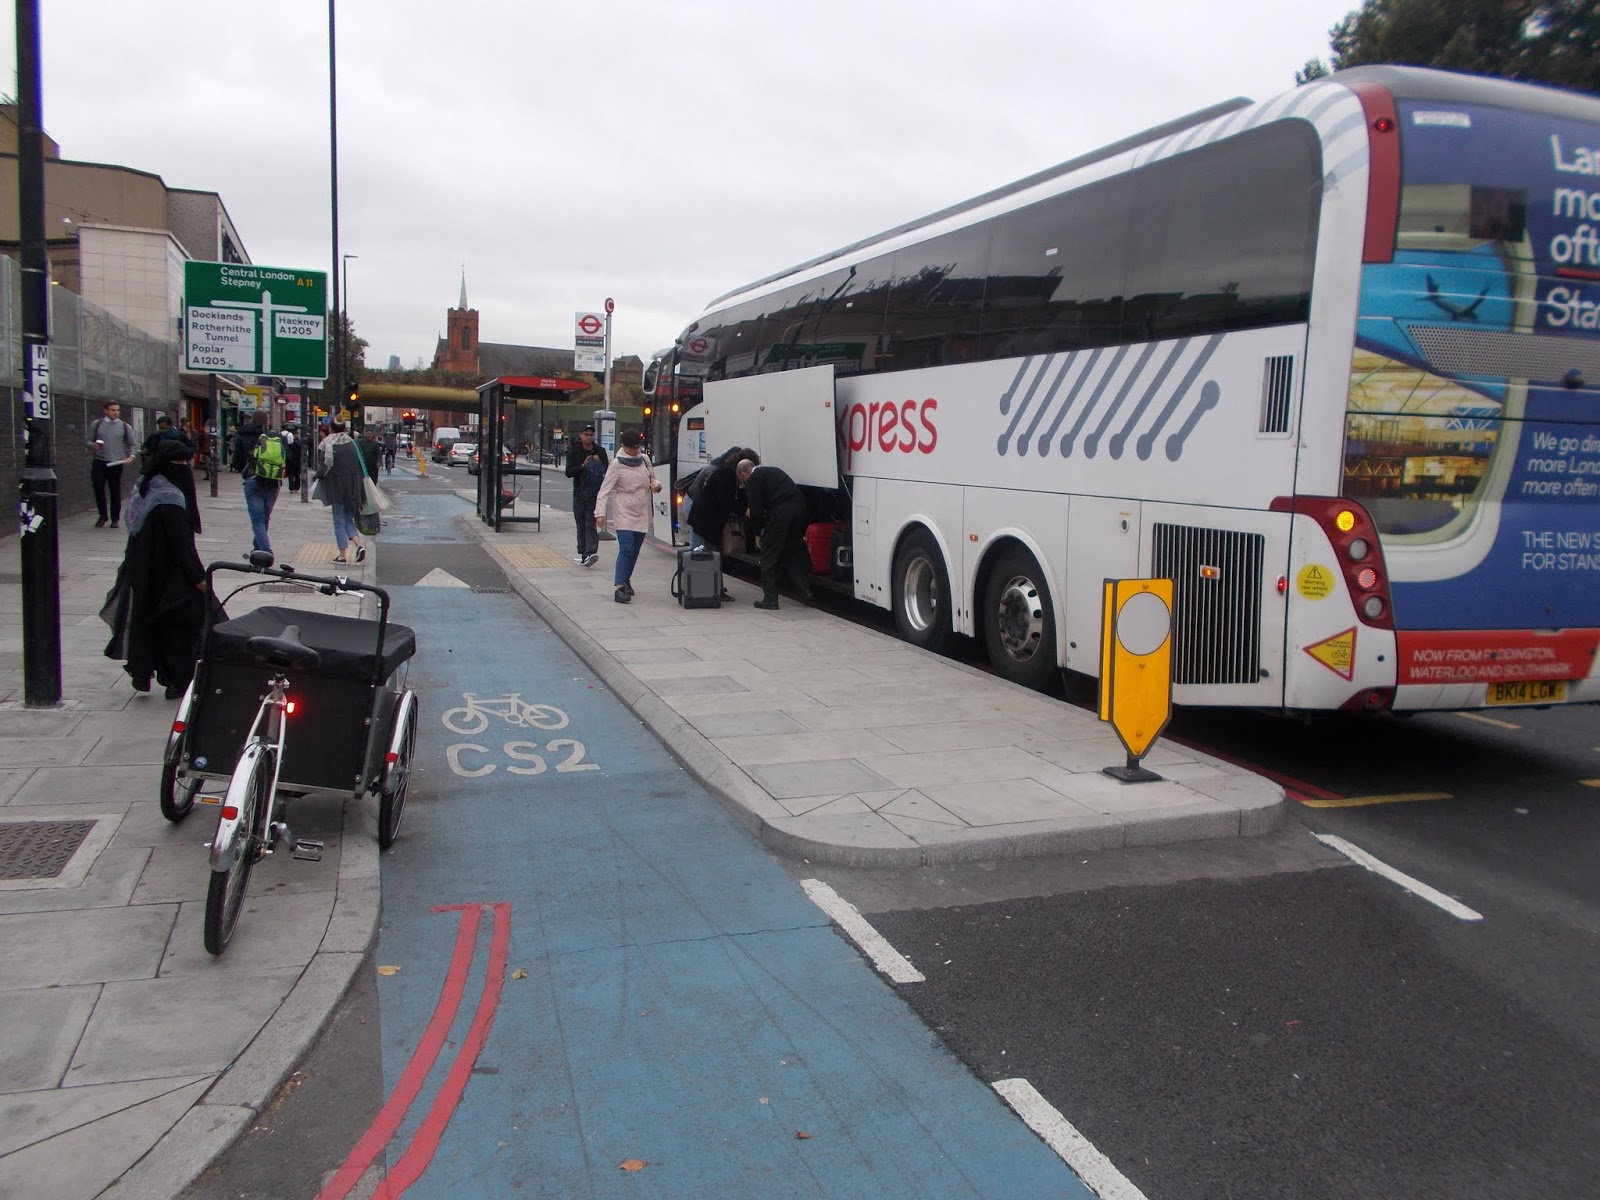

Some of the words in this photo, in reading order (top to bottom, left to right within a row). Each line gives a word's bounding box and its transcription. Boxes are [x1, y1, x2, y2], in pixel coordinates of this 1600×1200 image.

[1551, 224, 1600, 265] oft
[220, 266, 258, 278] Central
[260, 270, 295, 281] London
[220, 276, 262, 289] Stepney
[1547, 286, 1600, 328] Sta
[191, 309, 244, 321] Docklands
[278, 316, 320, 328] Hackney
[191, 322, 252, 334] Rotherhithe
[279, 326, 313, 336] A1205
[205, 332, 239, 343] Tunnel
[192, 343, 225, 354] Poplar
[192, 356, 226, 366] A1205
[1533, 431, 1557, 450] We
[1558, 438, 1579, 455] go
[1527, 458, 1567, 473] more
[1522, 480, 1562, 495] more
[1563, 477, 1597, 496] often
[1522, 531, 1554, 548] THE
[1557, 531, 1591, 549] NEW
[1522, 552, 1556, 570] FOR
[1413, 650, 1445, 662] NOW
[1446, 650, 1482, 661] FROM
[1484, 647, 1556, 660] PDDINGTON
[1409, 666, 1477, 679] WATERLOO
[1477, 665, 1504, 677] AND
[1495, 682, 1526, 701] BK14
[446, 738, 601, 778] CS2
